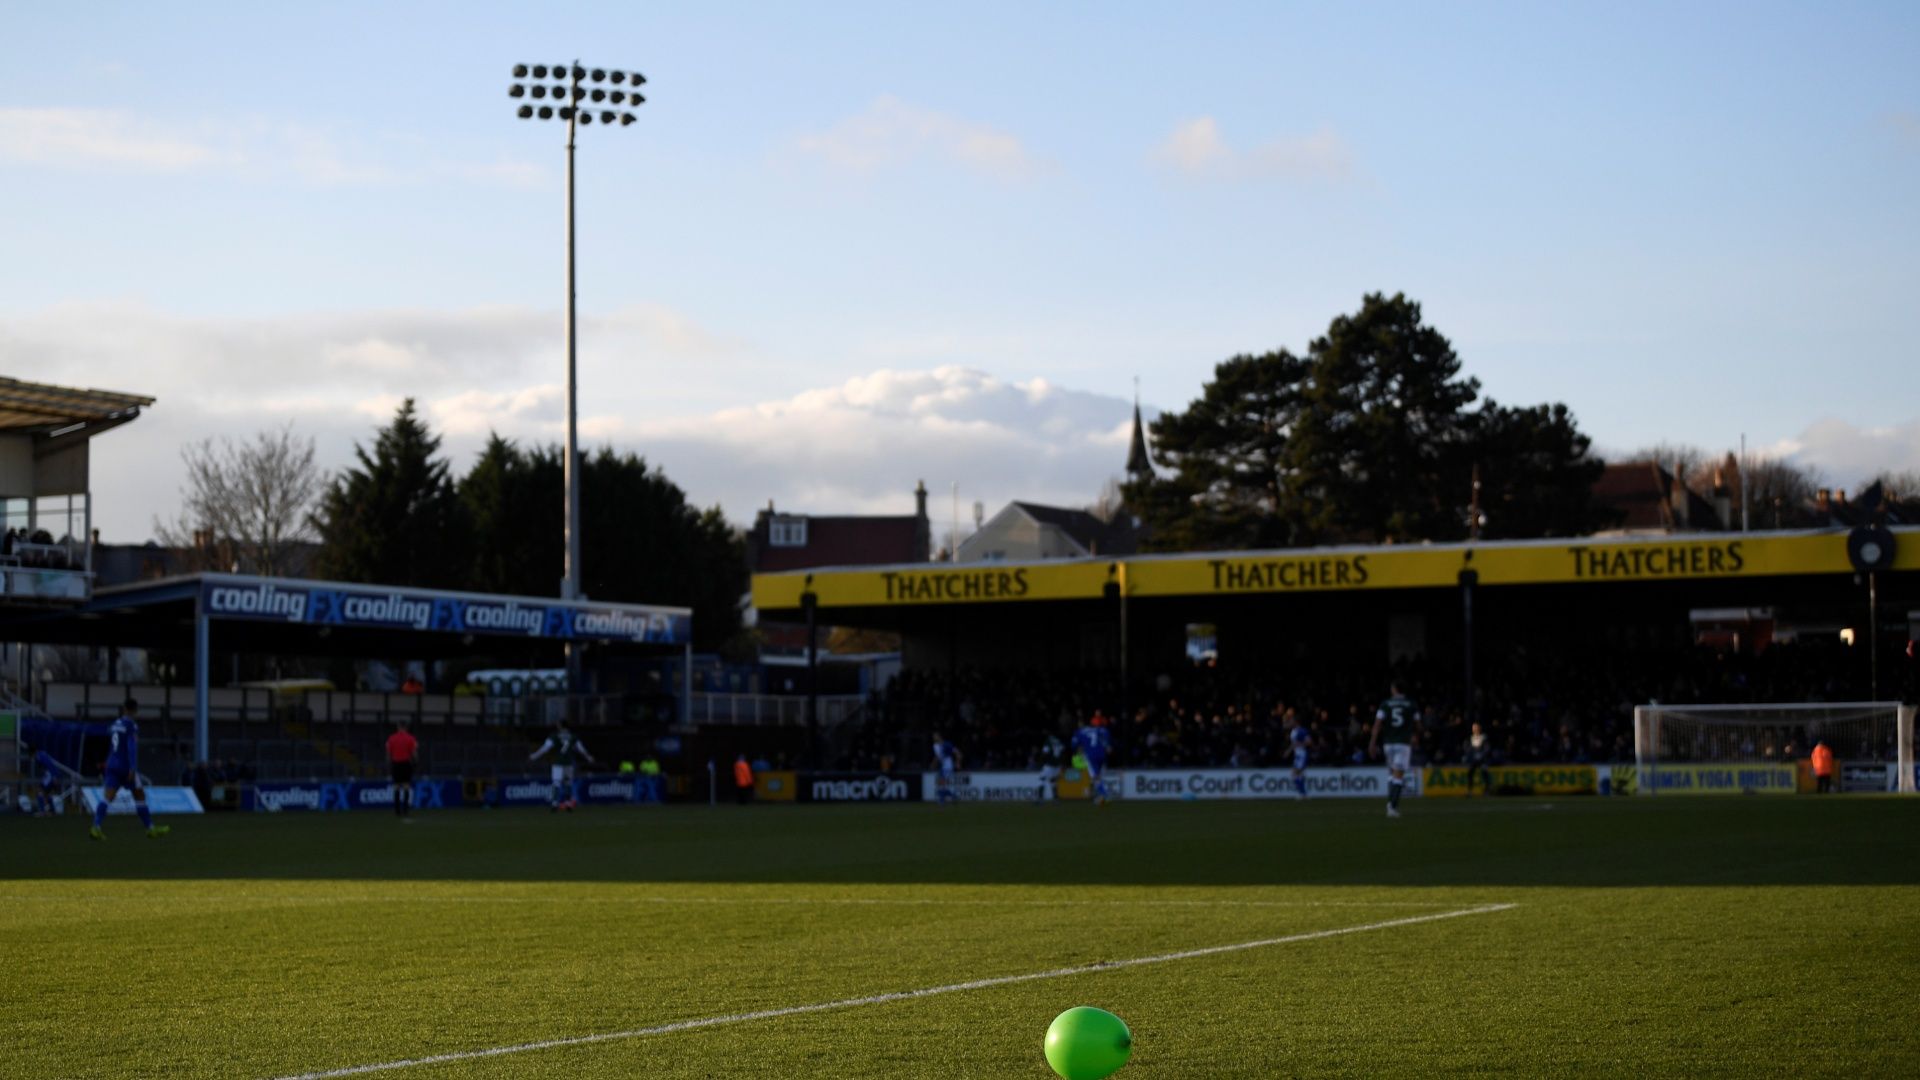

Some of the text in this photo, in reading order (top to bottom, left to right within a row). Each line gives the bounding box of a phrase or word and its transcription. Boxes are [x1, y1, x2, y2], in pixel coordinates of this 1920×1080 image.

[1209, 555, 1369, 590] THATCHERS
[1569, 541, 1744, 577] THATCHERS
[881, 568, 1028, 600] THATCHERS
[1391, 707, 1404, 728] 5
[812, 775, 909, 801] macron
[1135, 775, 1182, 794] Barrs
[1188, 773, 1243, 794] Court
[1249, 772, 1379, 793] Conruction
